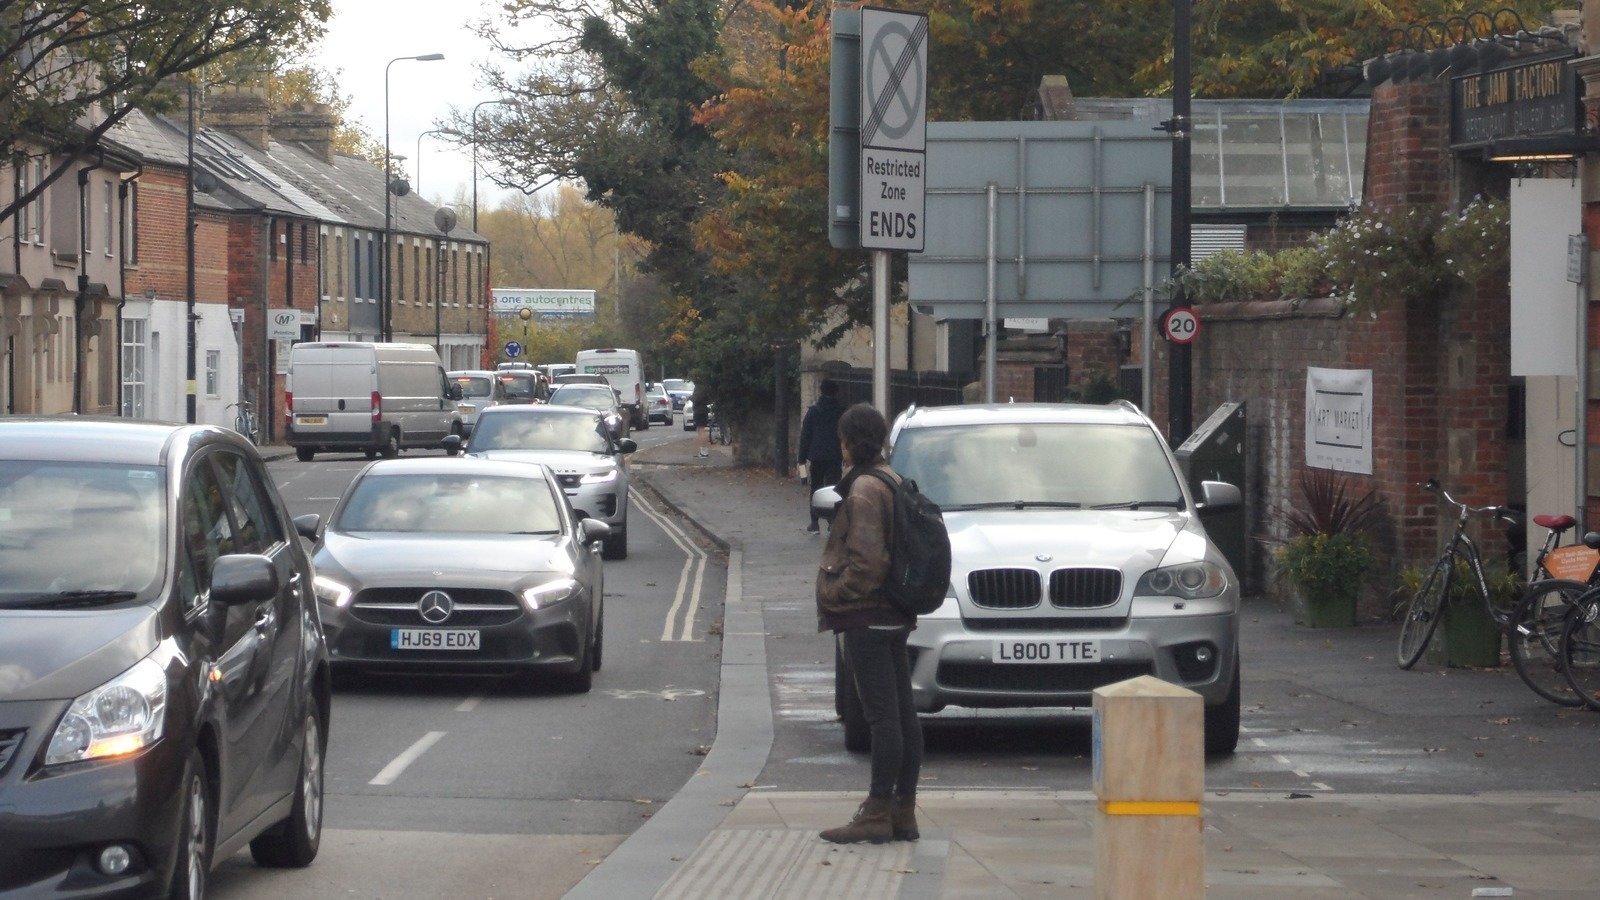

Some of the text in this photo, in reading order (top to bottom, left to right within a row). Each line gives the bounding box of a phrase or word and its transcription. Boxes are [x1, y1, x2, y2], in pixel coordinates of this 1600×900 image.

[1462, 62, 1561, 109] THE JAM FACTORY
[867, 157, 920, 178] Restricted
[881, 181, 906, 200] Zone
[870, 211, 917, 239] ENDS
[525, 294, 592, 305] autocentres
[1171, 318, 1195, 333] 20
[1317, 409, 1329, 427] ART
[1334, 410, 1359, 430] MARKET
[402, 632, 476, 647] HJ69 EOX
[1000, 642, 1093, 660] L800 TTE
